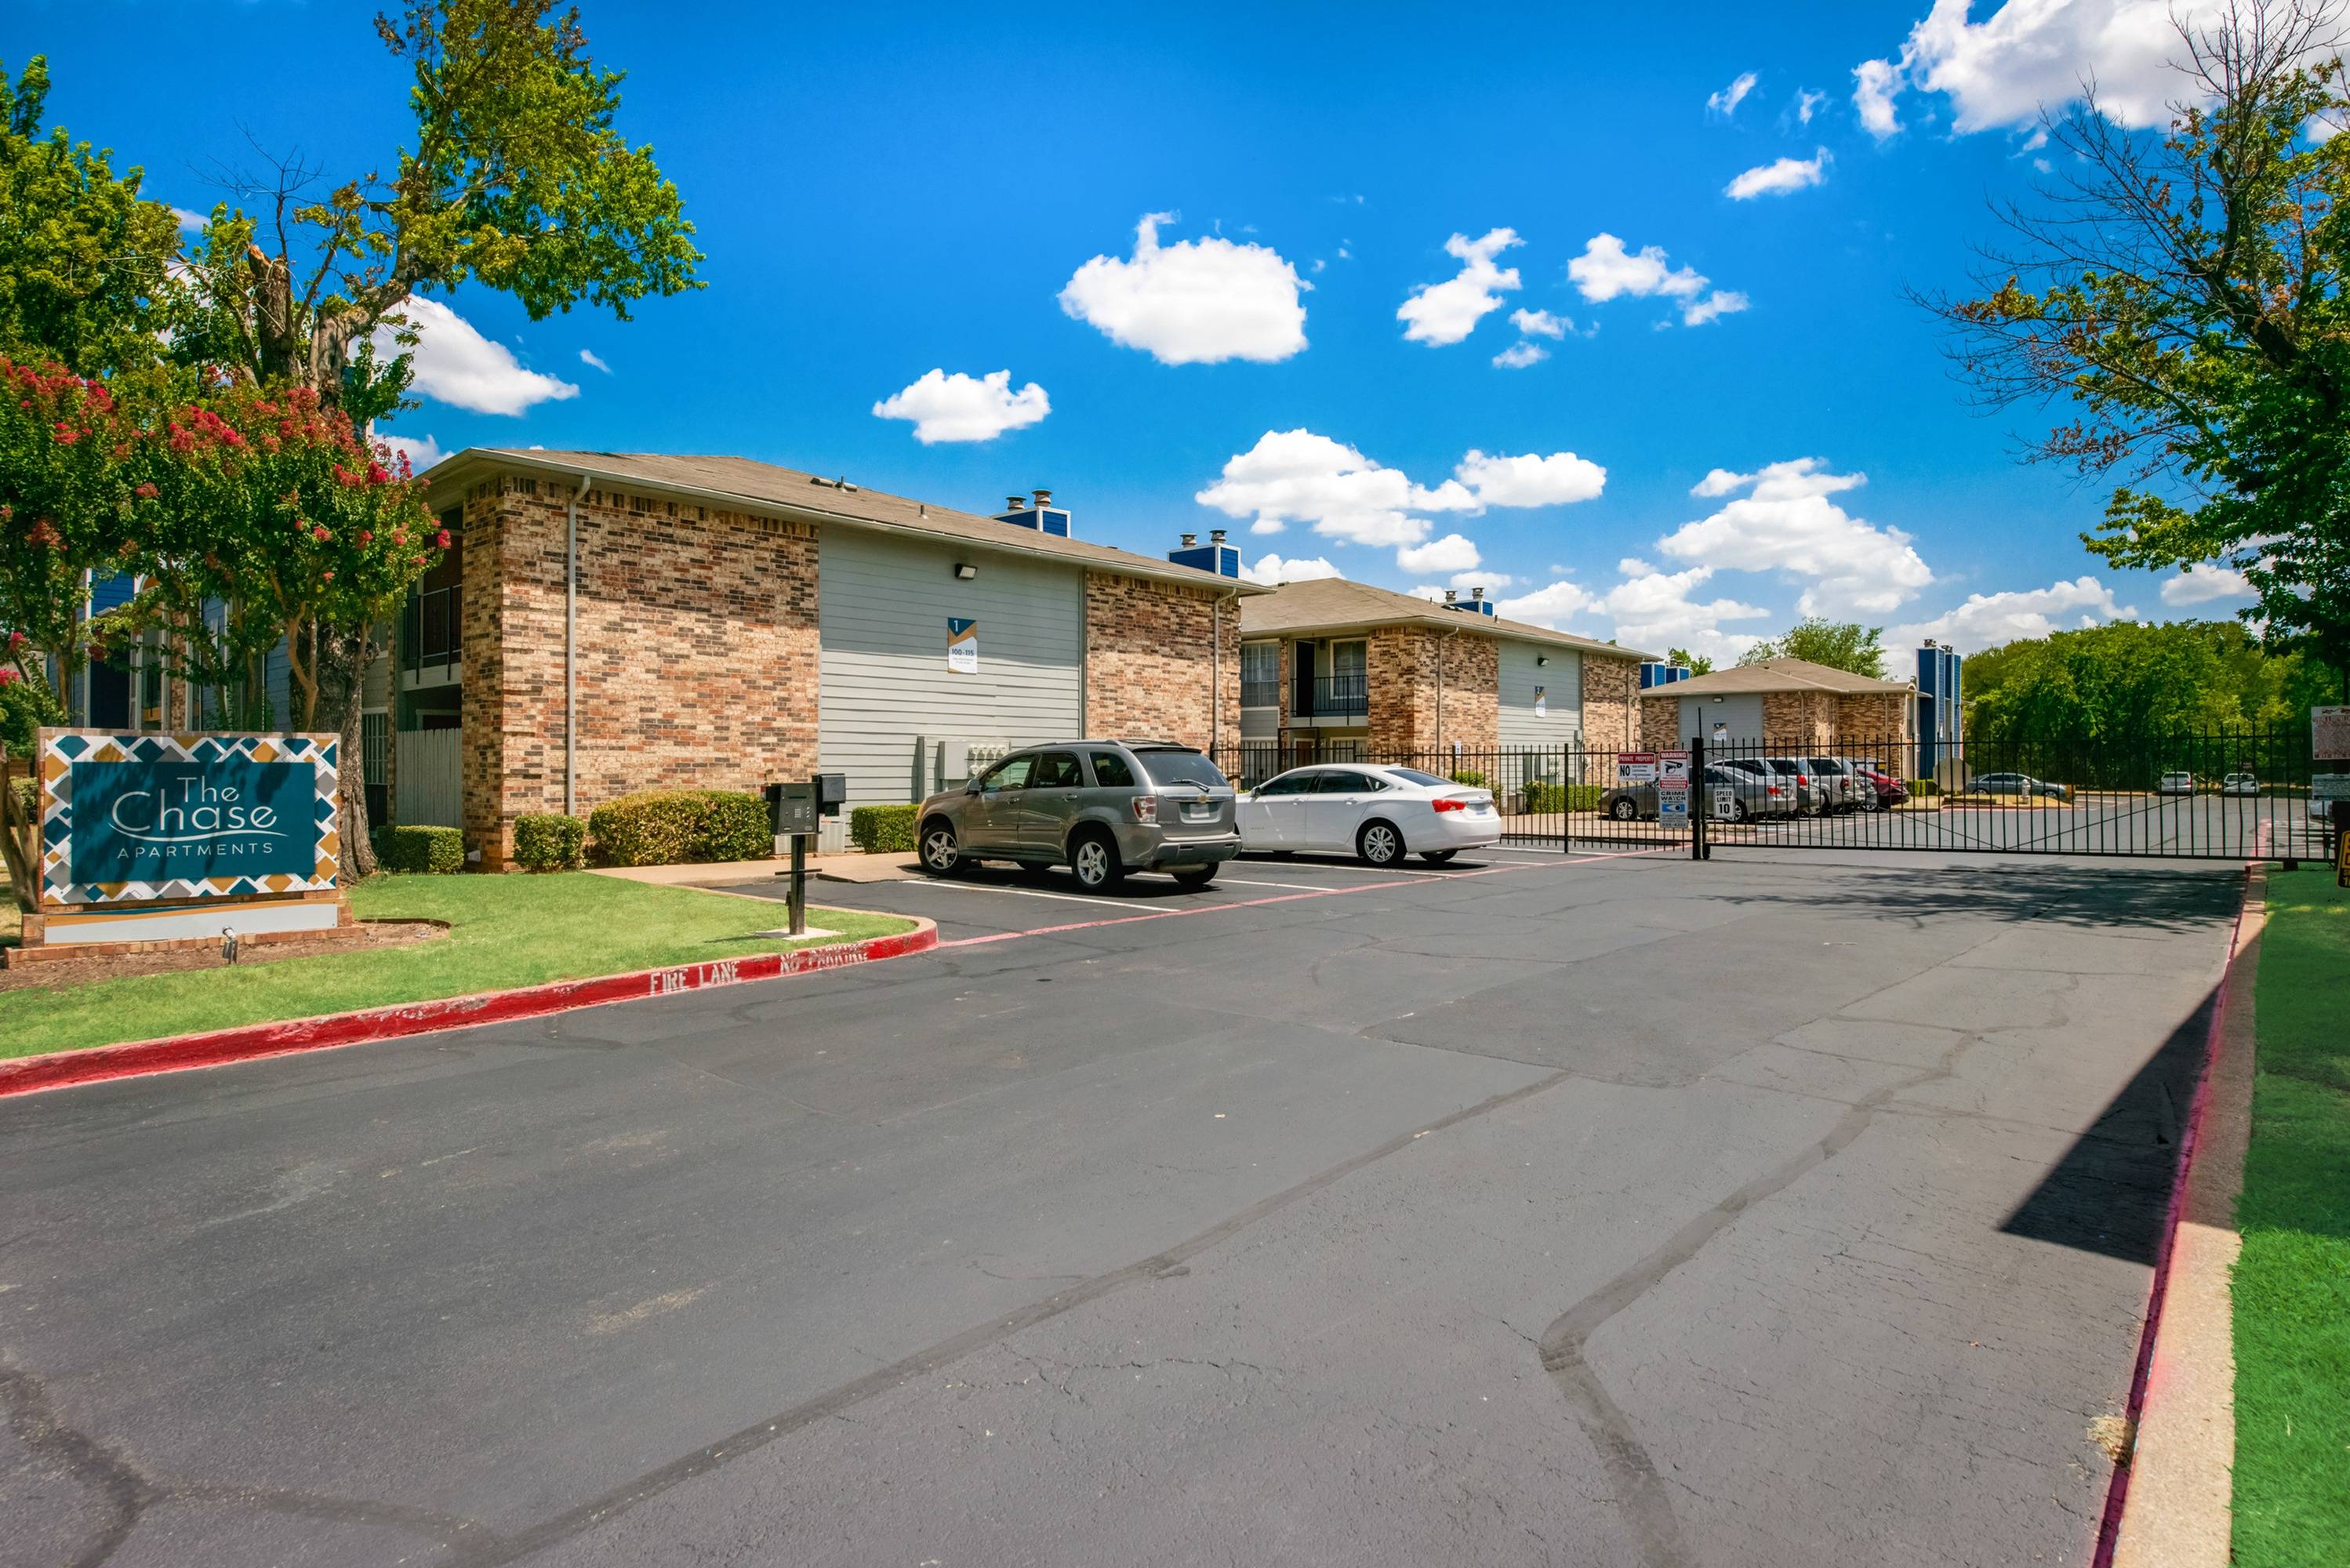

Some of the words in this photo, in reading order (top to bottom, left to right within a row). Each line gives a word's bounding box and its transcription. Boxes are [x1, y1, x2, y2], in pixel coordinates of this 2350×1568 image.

[953, 619, 958, 632] 1
[1620, 764, 1630, 776] NO
[176, 775, 239, 803] The
[112, 789, 277, 831] Chase
[1719, 804, 1730, 814] 10
[118, 843, 273, 859] APARTMENTS
[650, 968, 688, 996] FIRE
[699, 960, 742, 987] LANE
[780, 953, 799, 975] NO
